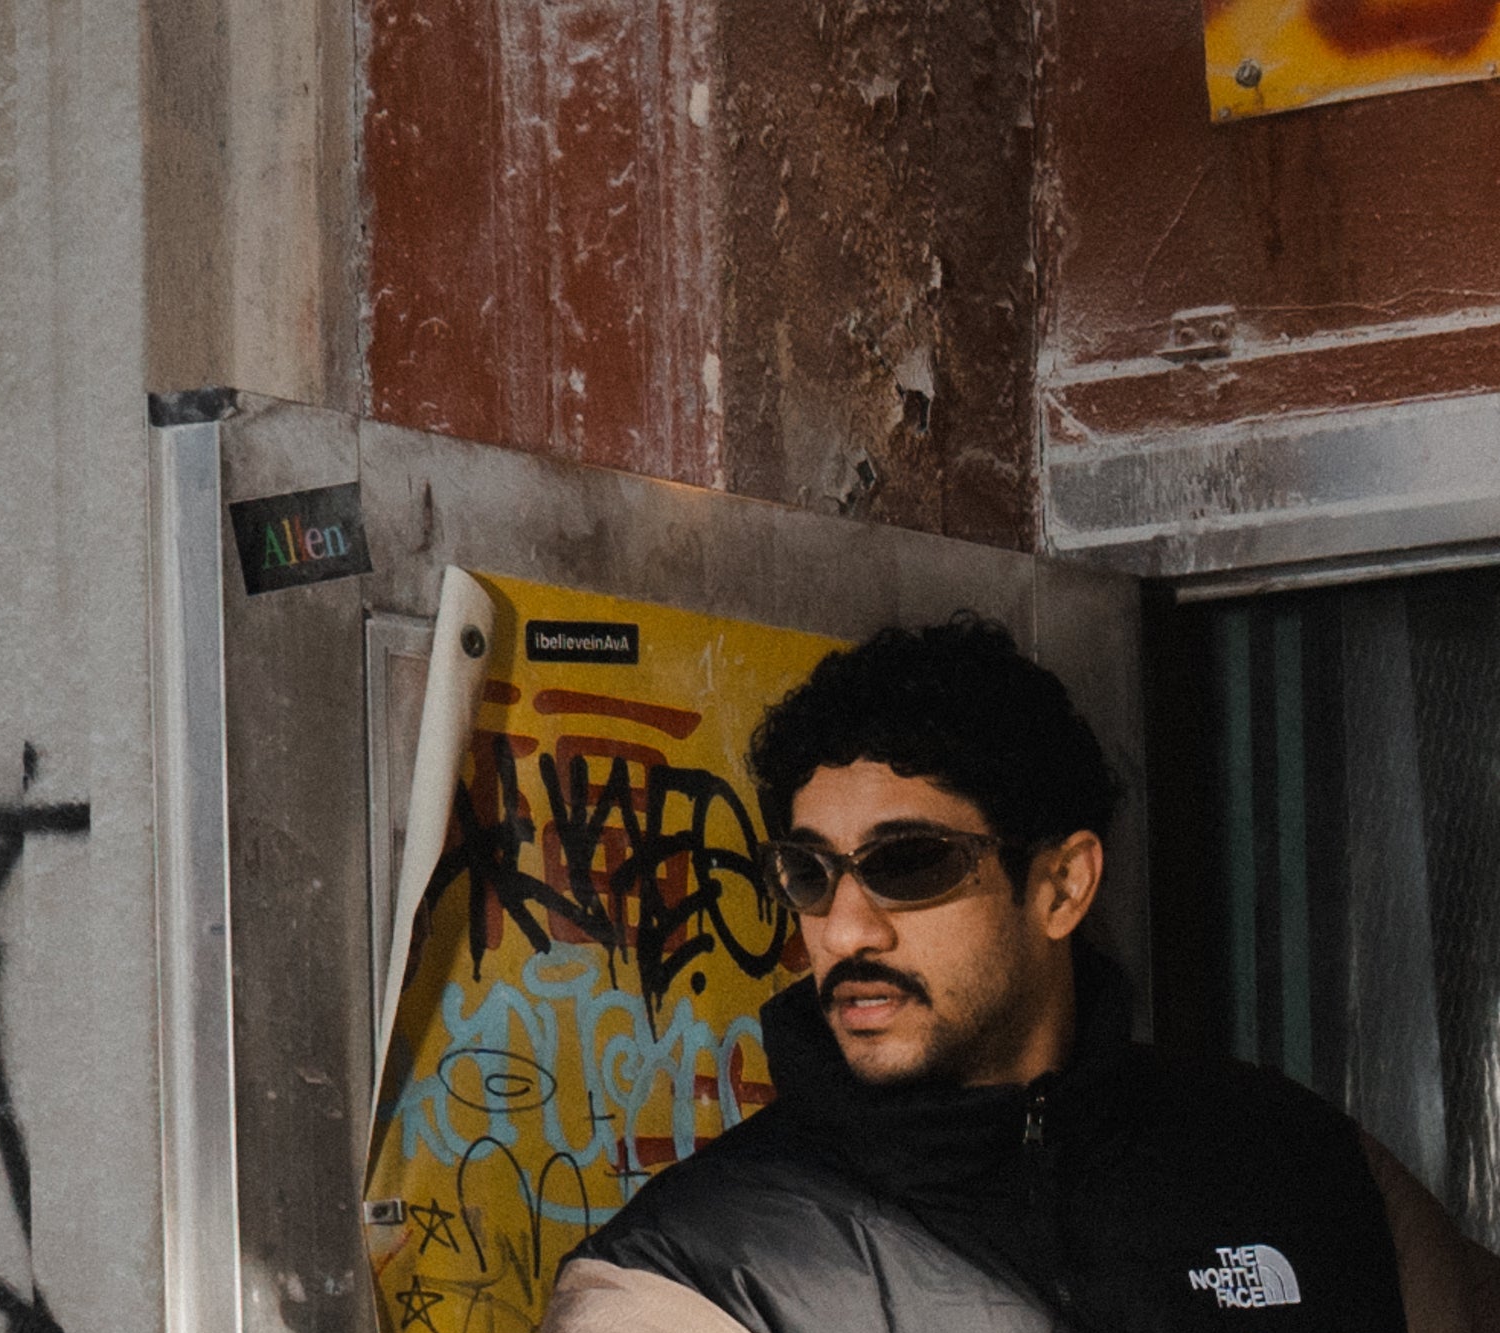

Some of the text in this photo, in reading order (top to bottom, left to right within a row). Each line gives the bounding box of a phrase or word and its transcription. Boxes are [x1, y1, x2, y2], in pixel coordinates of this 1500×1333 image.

[262, 513, 350, 570] Allen
[1215, 1246, 1257, 1267] THE
[1188, 1267, 1260, 1290] NORTH
[1216, 1286, 1266, 1308] FACE
